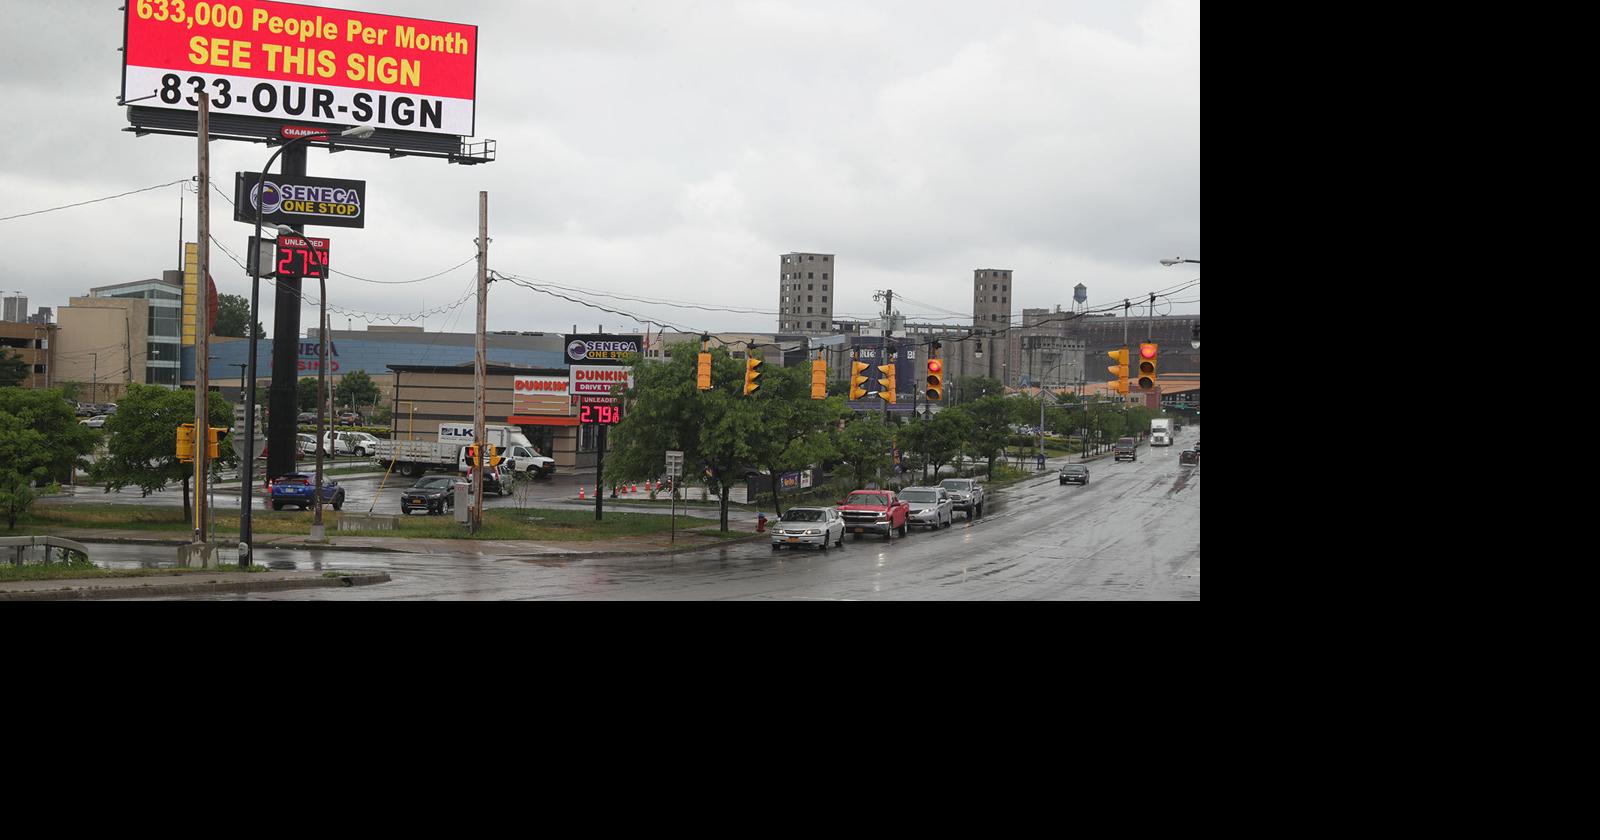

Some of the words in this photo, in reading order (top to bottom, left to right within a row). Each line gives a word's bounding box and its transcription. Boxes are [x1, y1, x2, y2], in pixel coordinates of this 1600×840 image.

[136, 0, 243, 29] 633,000
[252, 8, 338, 43] People
[346, 19, 388, 46] Per
[395, 25, 468, 55] Month
[188, 35, 252, 69] SEE
[262, 43, 337, 79] THIS
[346, 53, 421, 87] SIGN
[160, 73, 443, 129] 833-OUR-SIGN
[281, 185, 359, 204] SENECA
[284, 201, 314, 212] ONE
[319, 204, 356, 215] STOP
[586, 341, 637, 352] SENECA
[580, 405, 612, 423] 2.79
